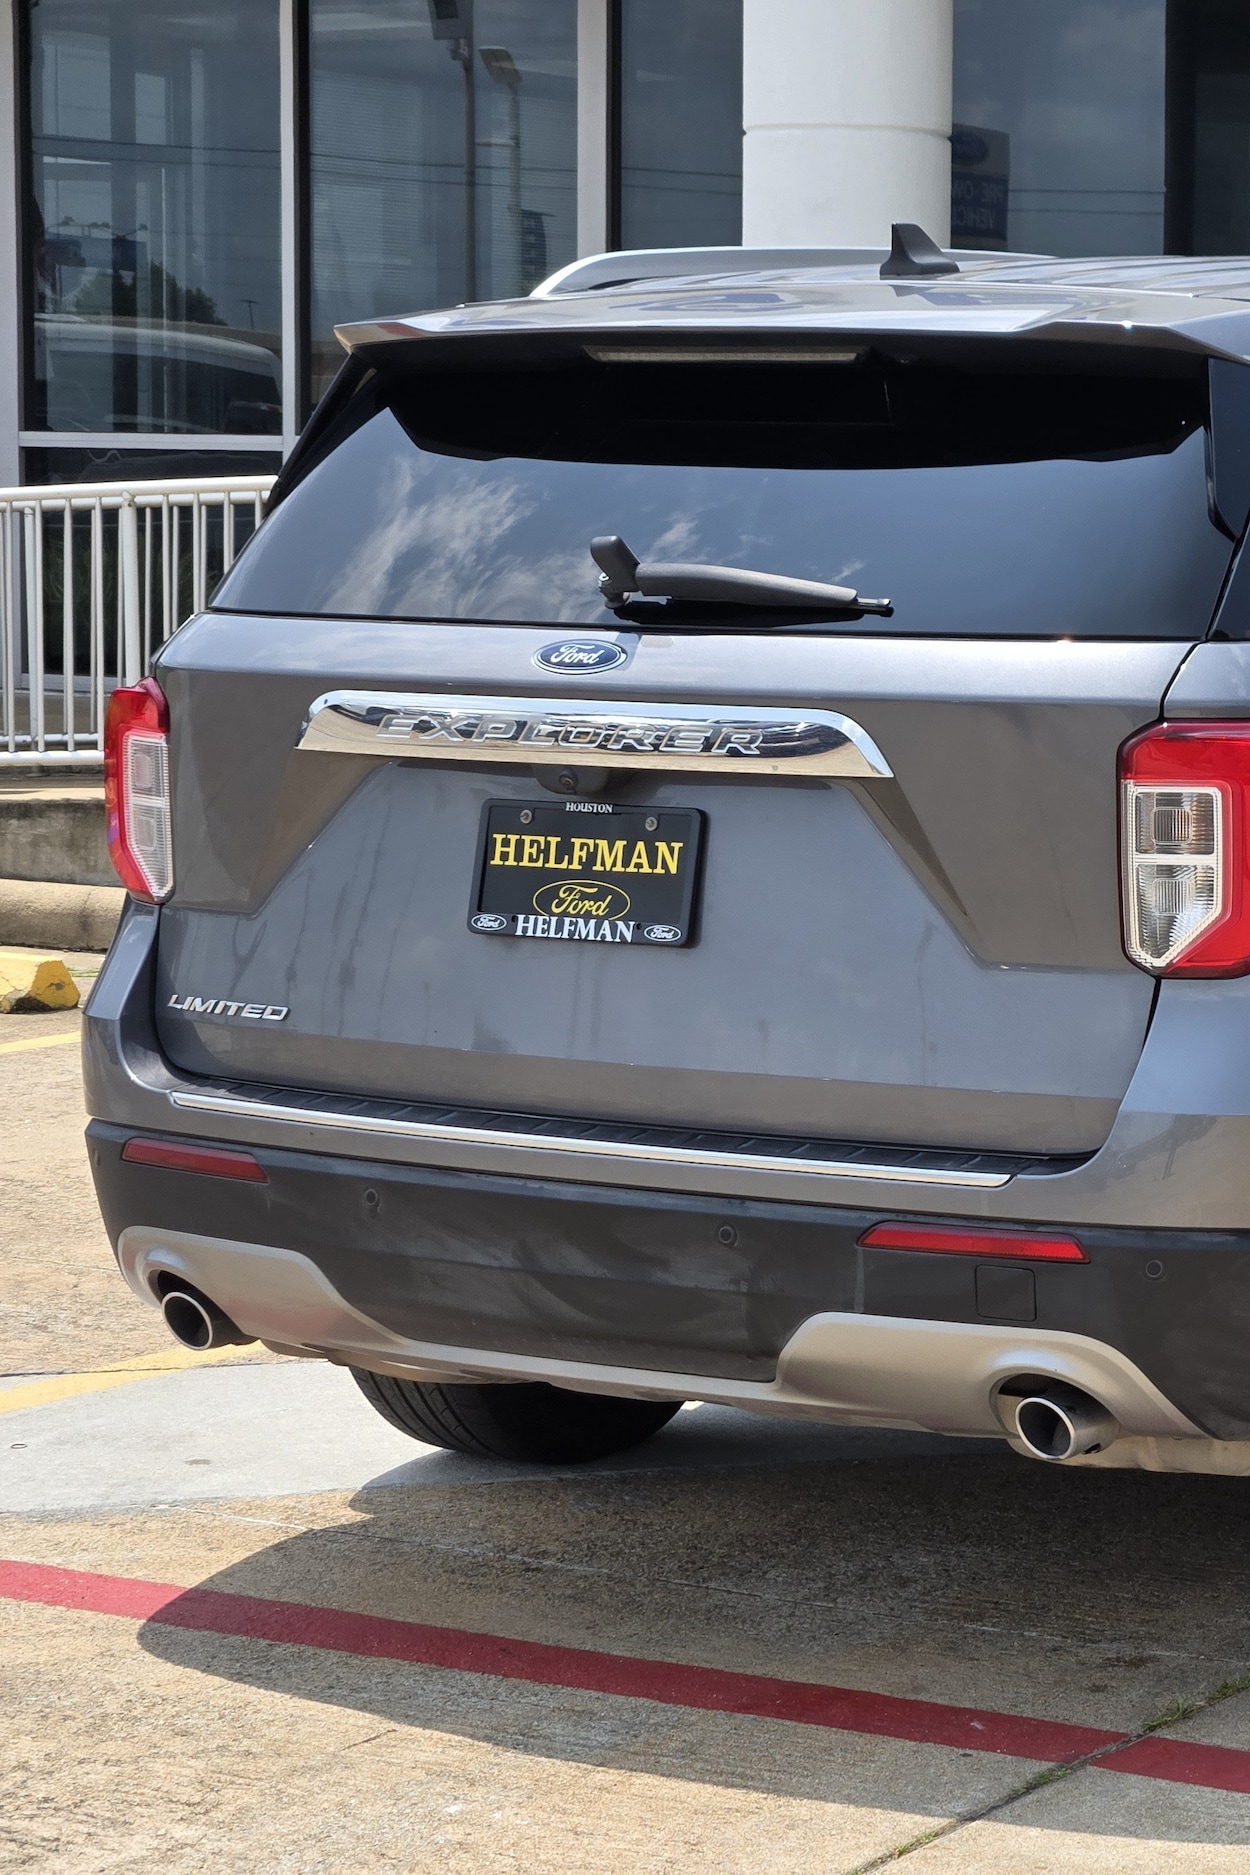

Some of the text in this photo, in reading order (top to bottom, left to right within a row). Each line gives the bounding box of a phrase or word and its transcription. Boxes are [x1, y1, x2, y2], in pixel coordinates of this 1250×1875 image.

[550, 642, 602, 666] Ford
[375, 713, 764, 756] EXPLORER
[565, 802, 613, 813] HOUSTON
[490, 833, 684, 875] HELFMAN
[551, 884, 613, 917] Ford
[476, 914, 675, 943] Ford HELFMAN Ford
[167, 994, 289, 1021] LIMITED
